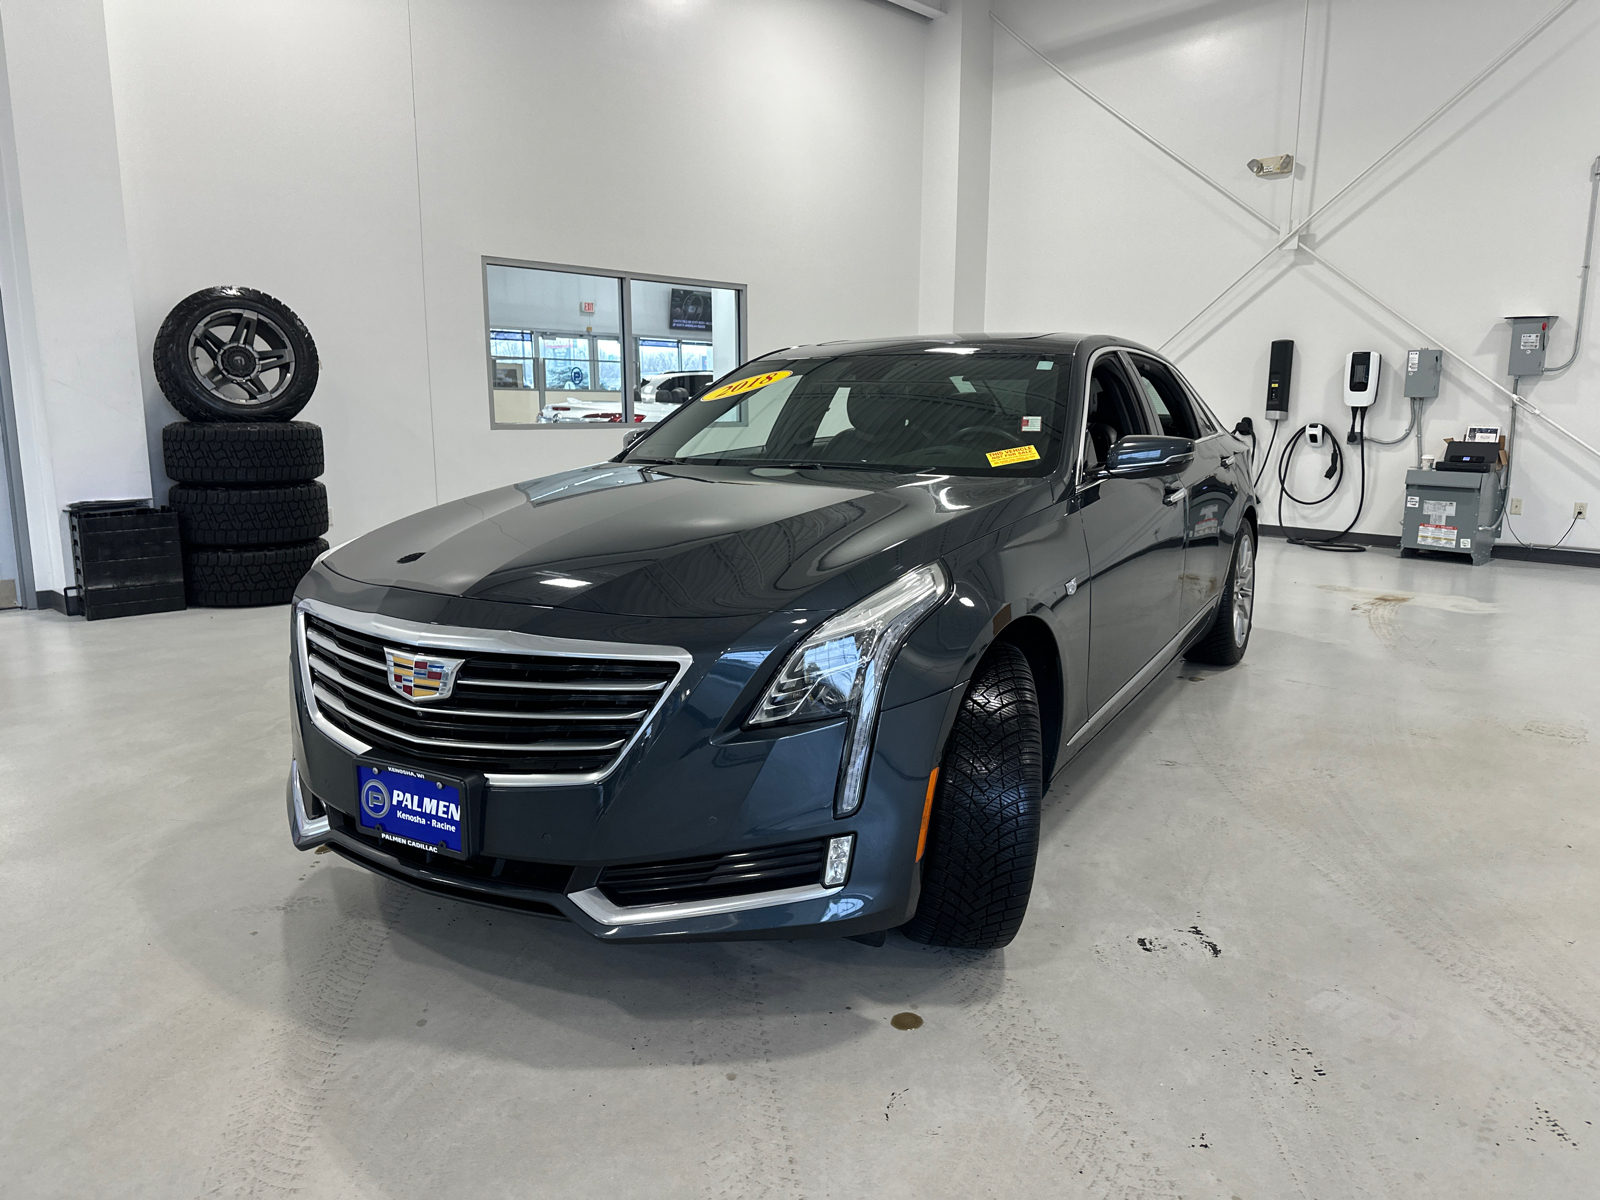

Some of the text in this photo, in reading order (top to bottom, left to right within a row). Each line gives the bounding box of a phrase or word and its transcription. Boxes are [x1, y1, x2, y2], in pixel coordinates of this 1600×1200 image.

[584, 302, 594, 311] EXIT
[714, 372, 778, 398] 2018
[388, 766, 416, 778] KENOSHA,
[392, 790, 460, 821] PALMEN
[396, 810, 425, 825] Kenosha
[432, 819, 456, 832] Racine
[381, 833, 438, 853] PALMEN CADILLAC
